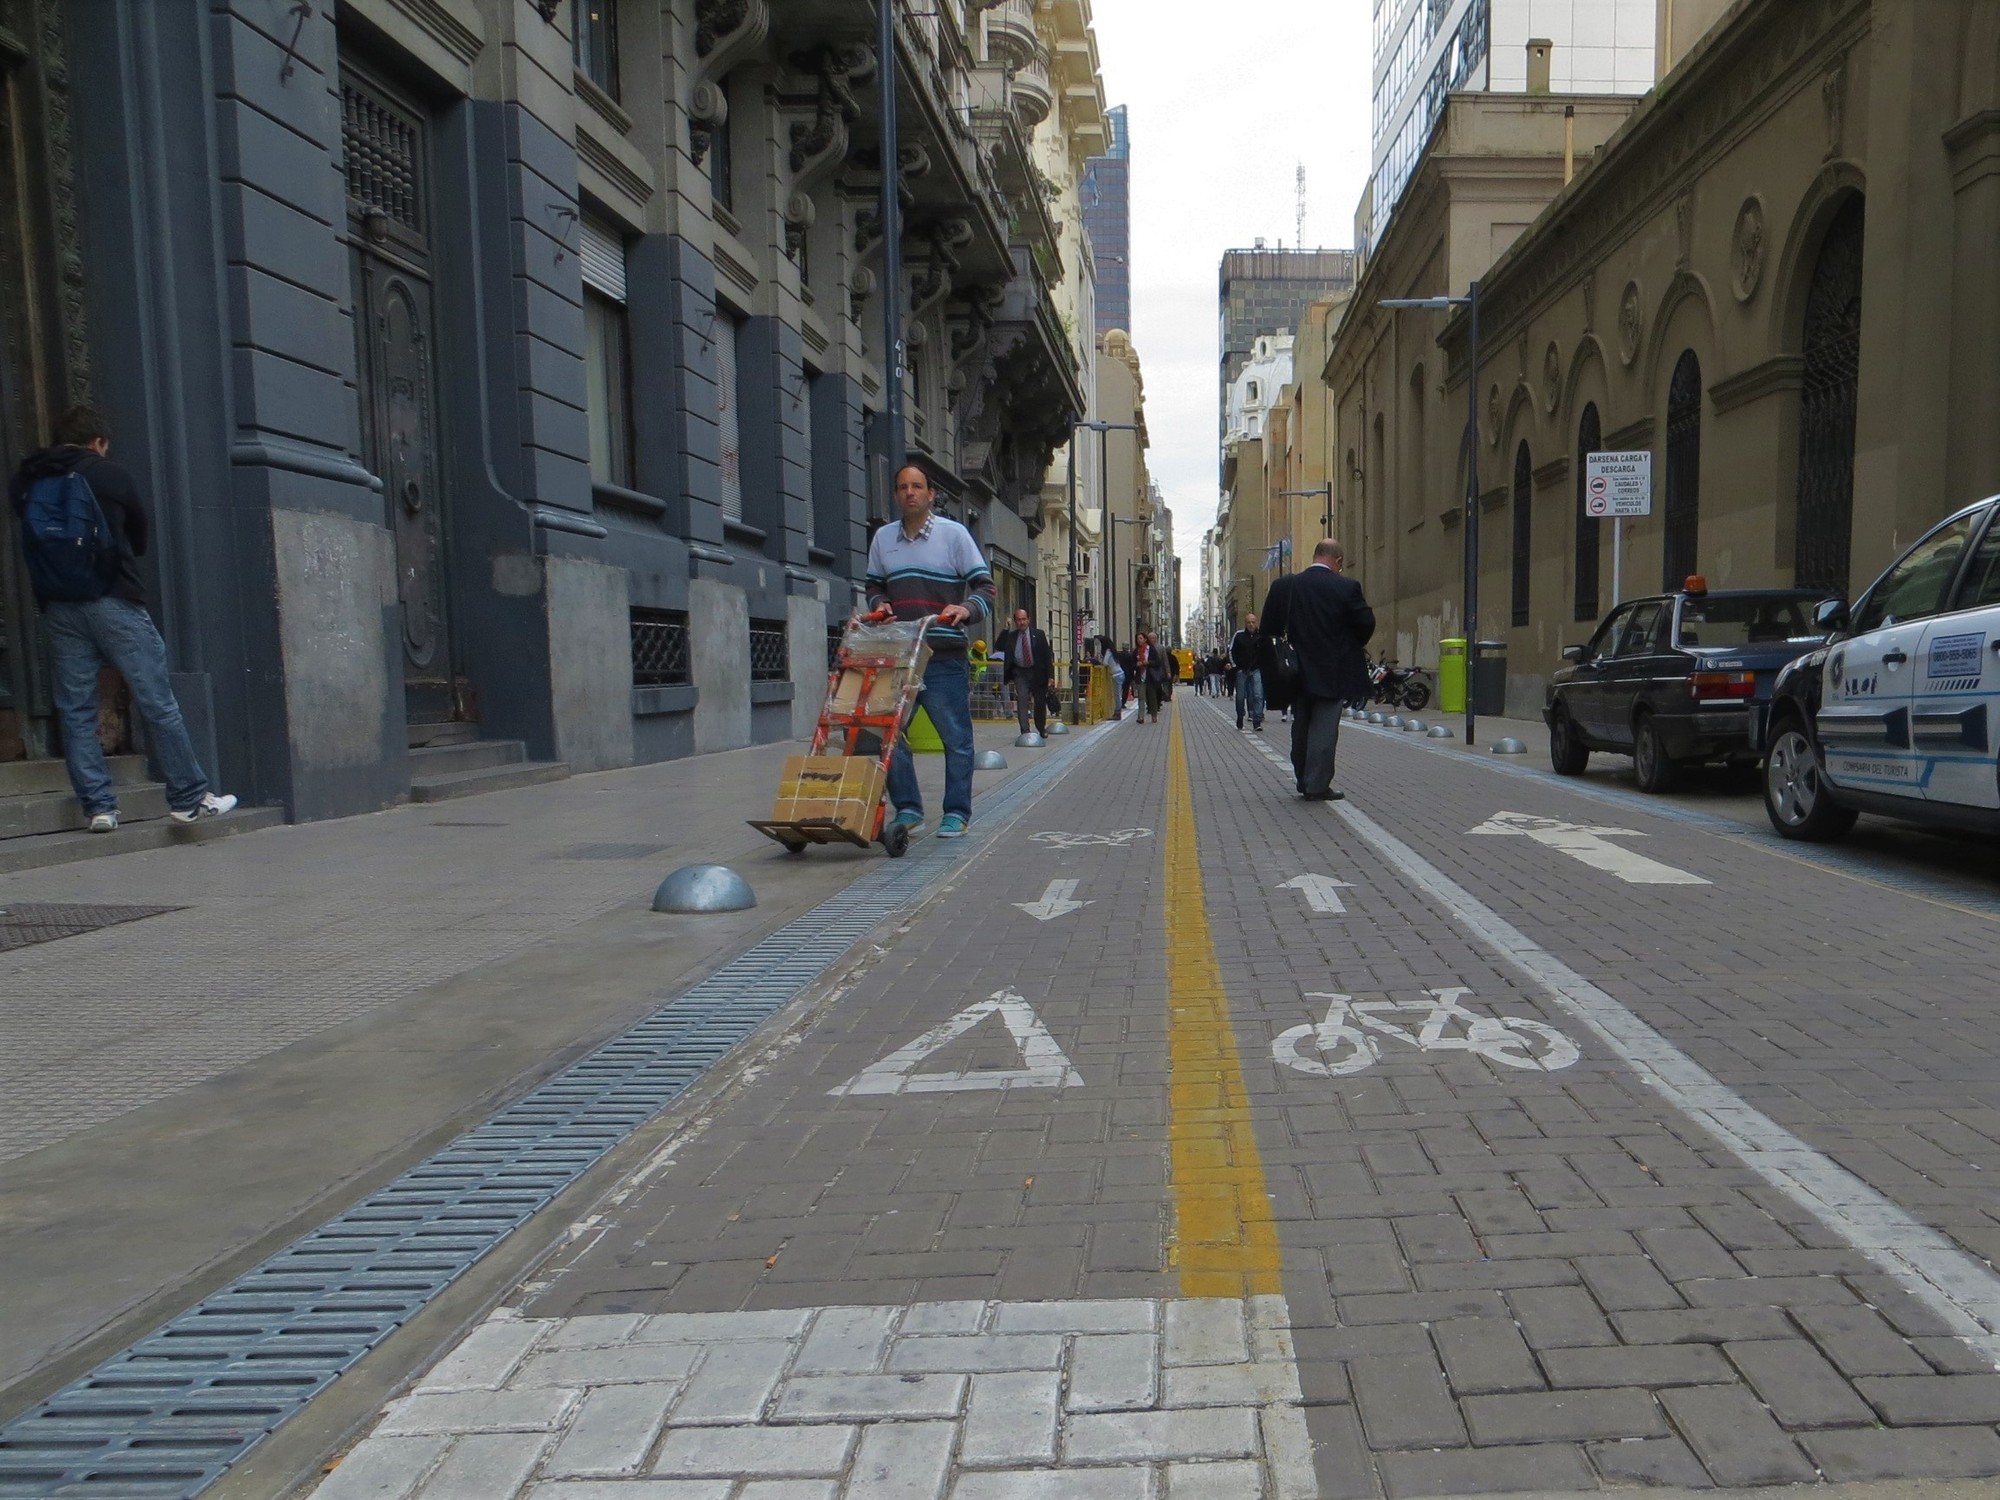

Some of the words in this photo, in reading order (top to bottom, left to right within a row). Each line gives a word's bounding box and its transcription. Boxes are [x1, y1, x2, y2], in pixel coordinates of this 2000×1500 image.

[1589, 455, 1619, 463] DARSENA
[1872, 763, 1882, 775] DEL
[1884, 764, 1909, 777] TURISTA
